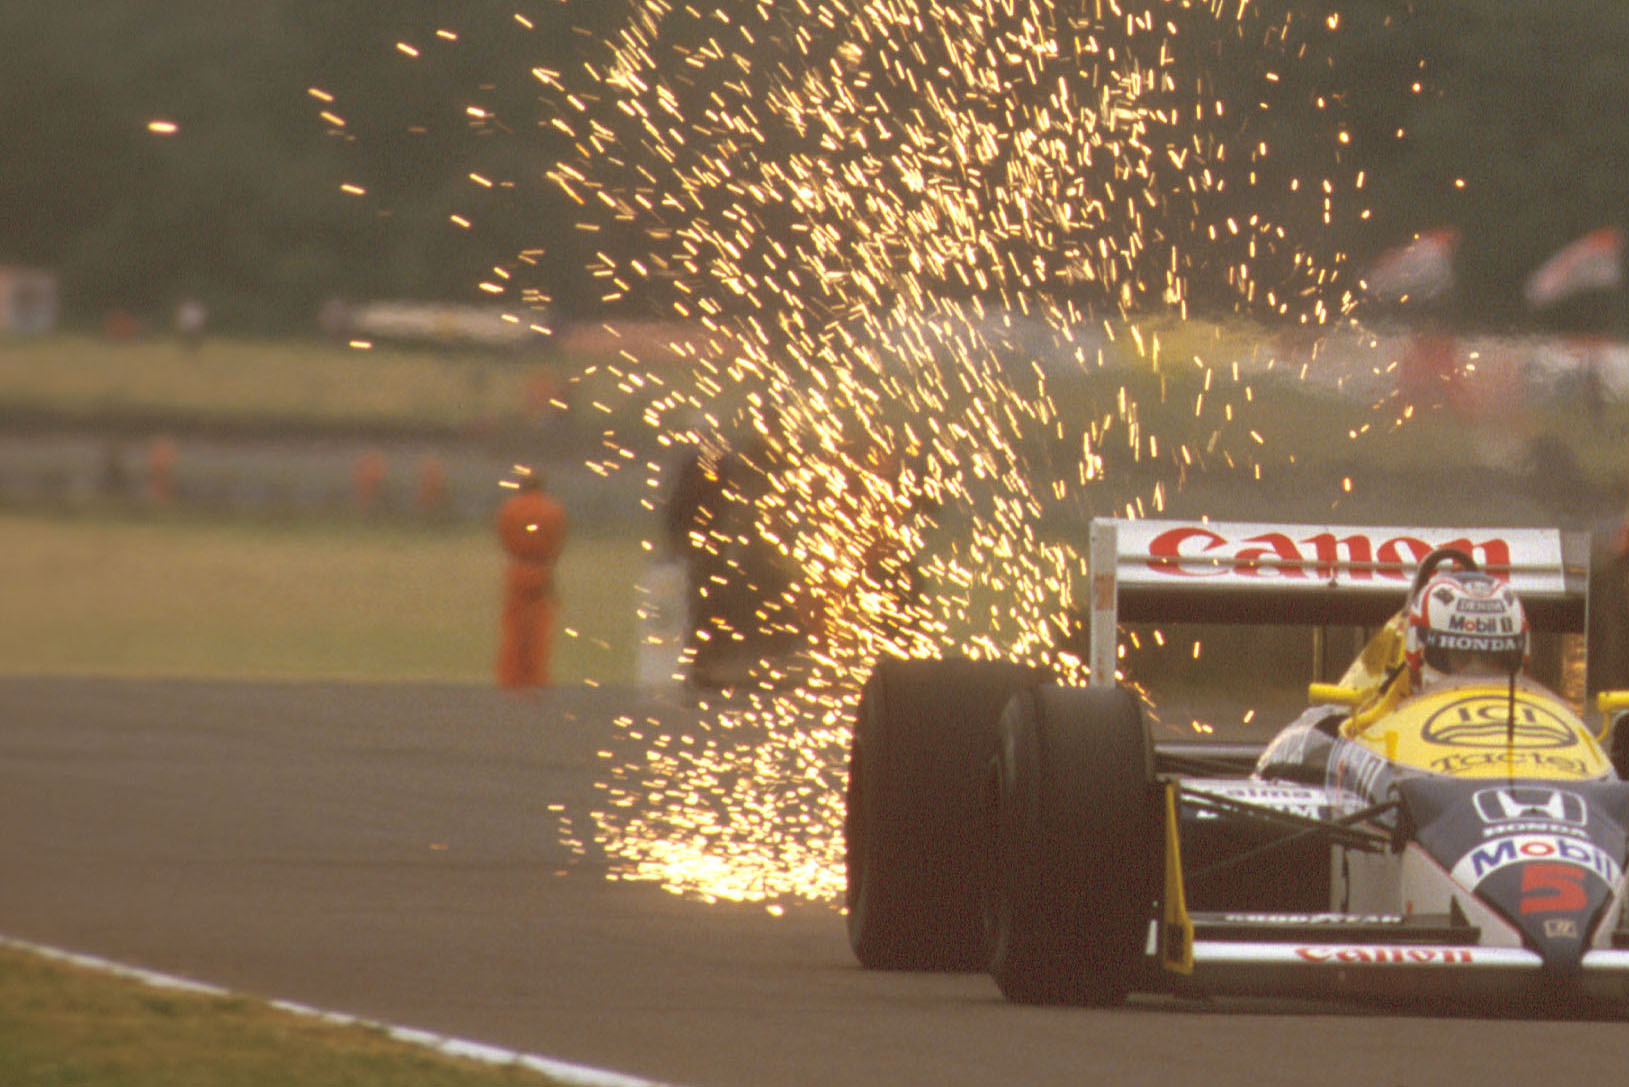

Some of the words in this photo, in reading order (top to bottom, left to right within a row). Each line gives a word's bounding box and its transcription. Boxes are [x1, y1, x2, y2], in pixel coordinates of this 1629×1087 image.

[1146, 527, 1512, 584] Canon
[1449, 614, 1497, 633] Mobil
[1440, 635, 1516, 651] HONDA
[1458, 705, 1536, 723] ICI
[1482, 822, 1591, 837] HONDA
[1472, 838, 1612, 879] Mobil
[1519, 864, 1588, 914] 5
[1295, 947, 1473, 963] Canon
